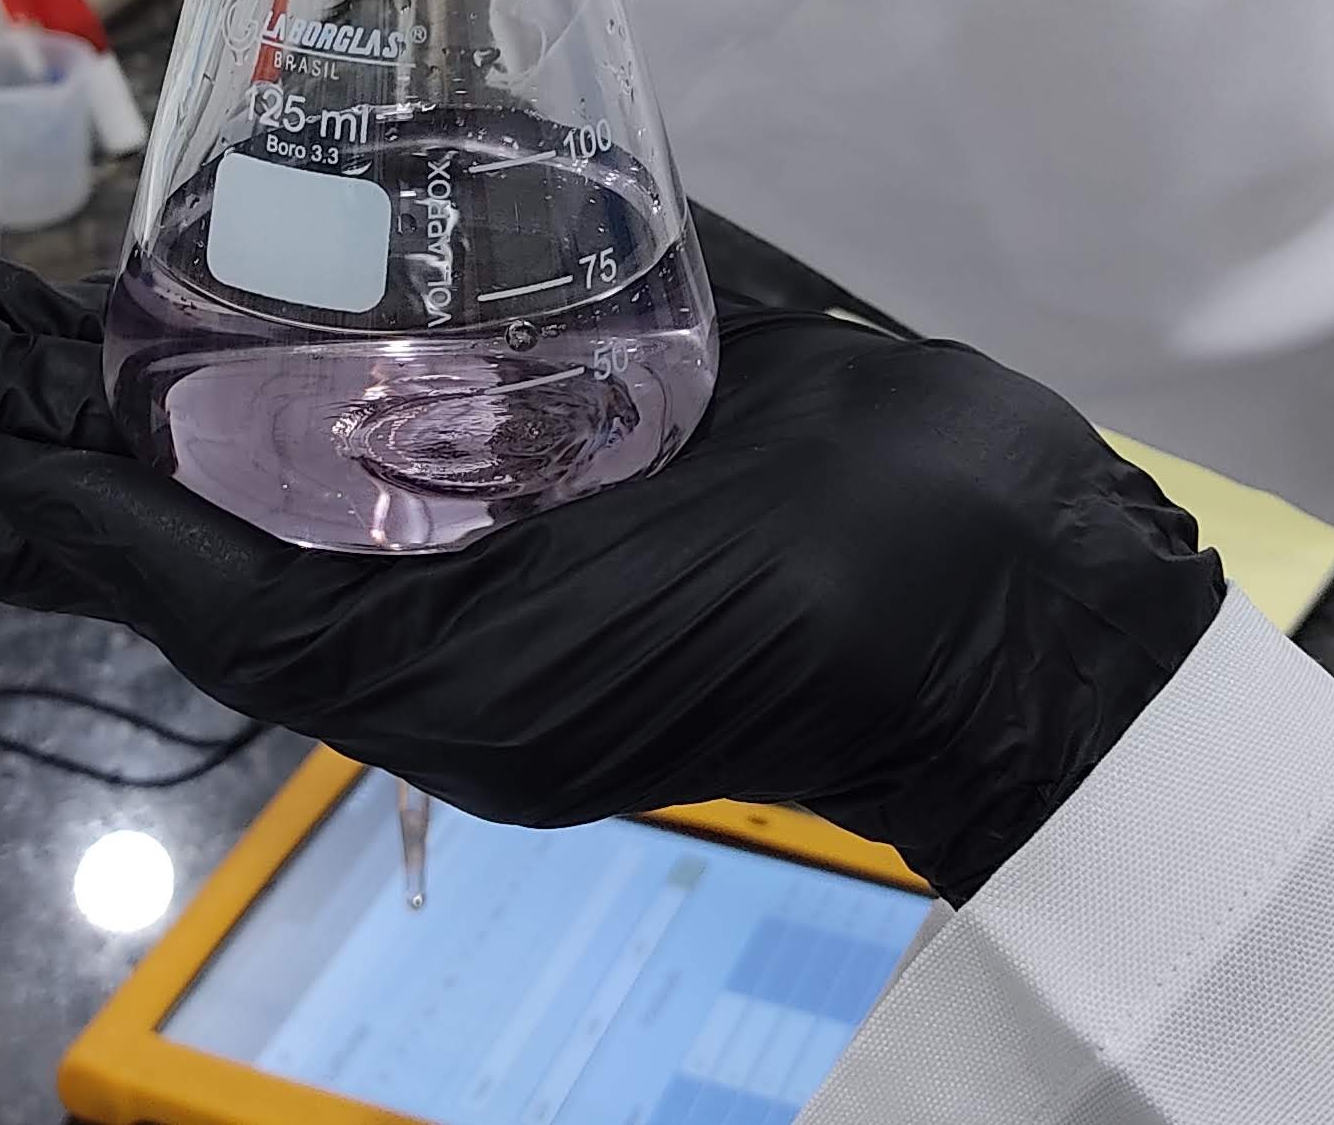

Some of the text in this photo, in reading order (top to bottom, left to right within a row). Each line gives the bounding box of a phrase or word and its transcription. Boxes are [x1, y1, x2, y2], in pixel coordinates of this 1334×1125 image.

[273, 51, 340, 81] BRASIL
[245, 81, 370, 145] 125 ml
[266, 133, 340, 165] Boro 3.3
[563, 118, 613, 161] 100
[578, 246, 618, 290] 75
[593, 342, 629, 382] 50
